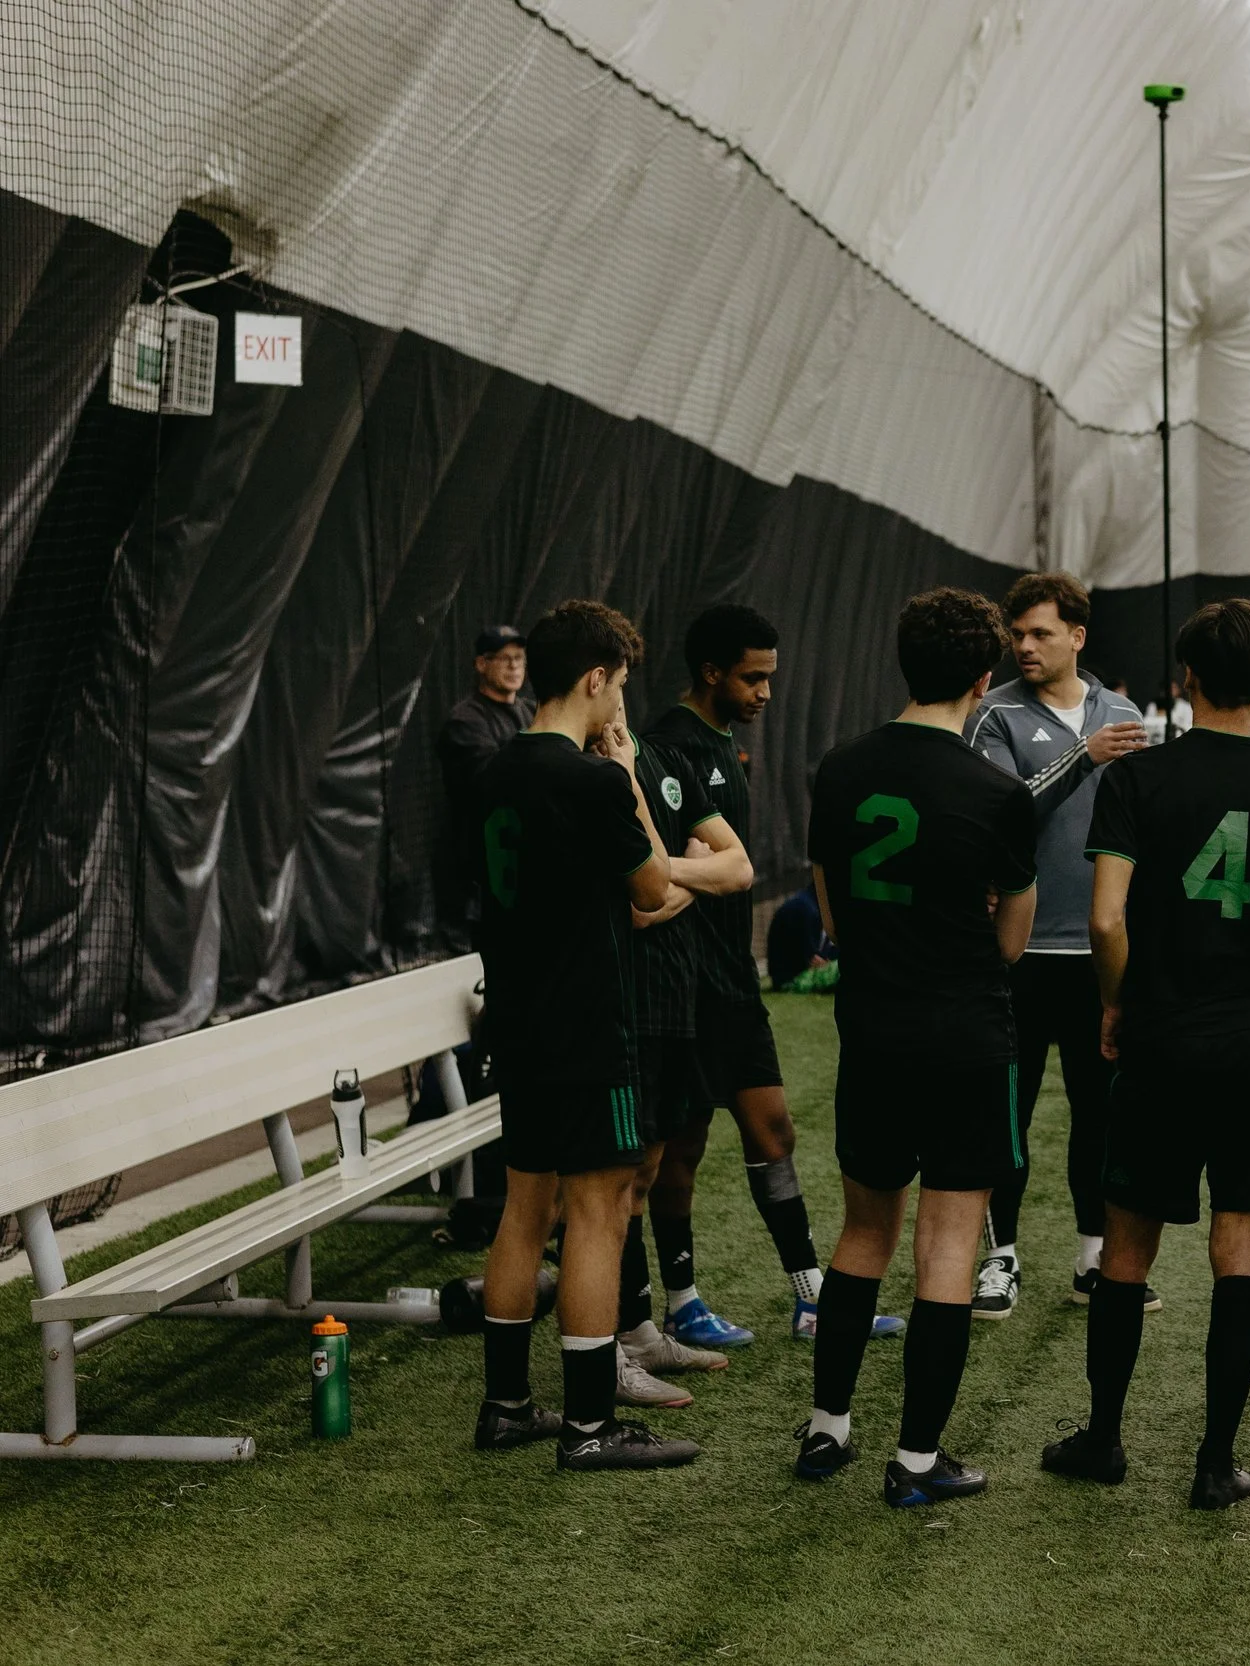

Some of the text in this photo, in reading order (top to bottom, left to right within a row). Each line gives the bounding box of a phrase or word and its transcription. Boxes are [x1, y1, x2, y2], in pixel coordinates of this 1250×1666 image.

[243, 334, 292, 361] EXIT
[483, 805, 523, 910] 6
[850, 793, 920, 906] 2
